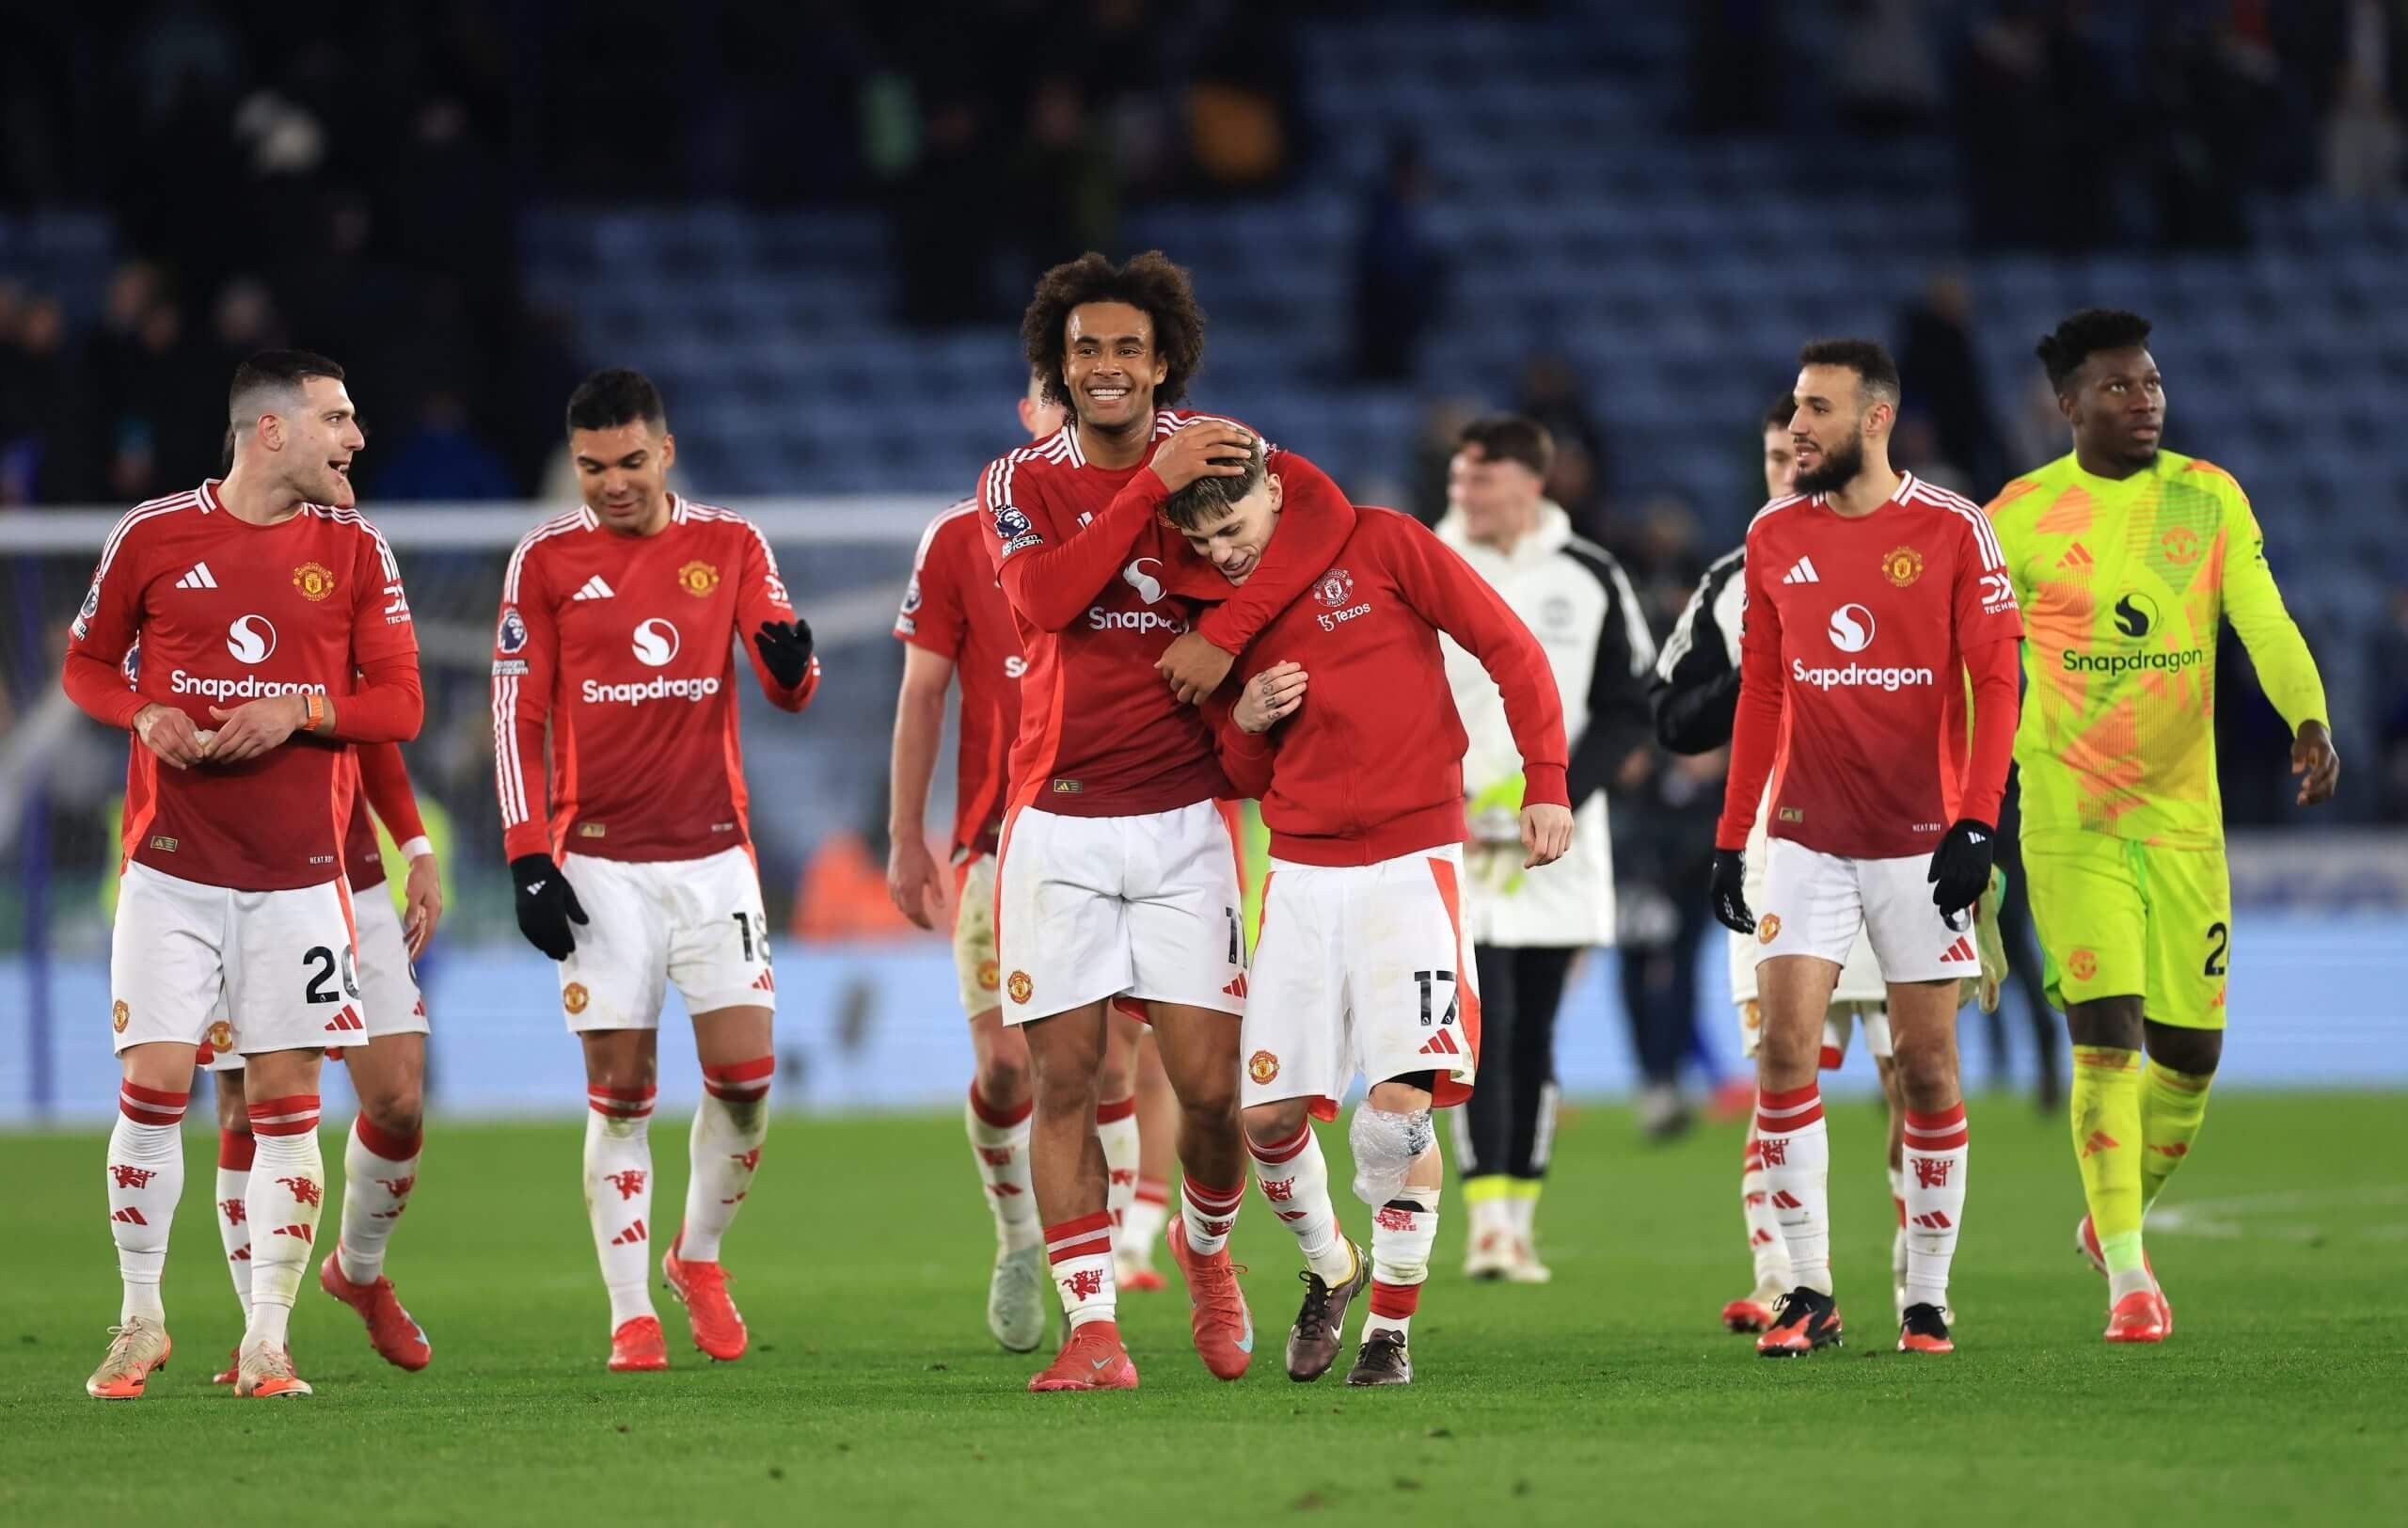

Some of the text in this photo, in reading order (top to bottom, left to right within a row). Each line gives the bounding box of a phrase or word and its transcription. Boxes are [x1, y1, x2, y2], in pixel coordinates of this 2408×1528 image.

[1332, 603, 1370, 623] Tezos
[2063, 649, 2203, 676] Snapdragon
[582, 675, 721, 707] Snapdrago
[2204, 921, 2230, 977] 2
[1414, 970, 1458, 1026] 17
